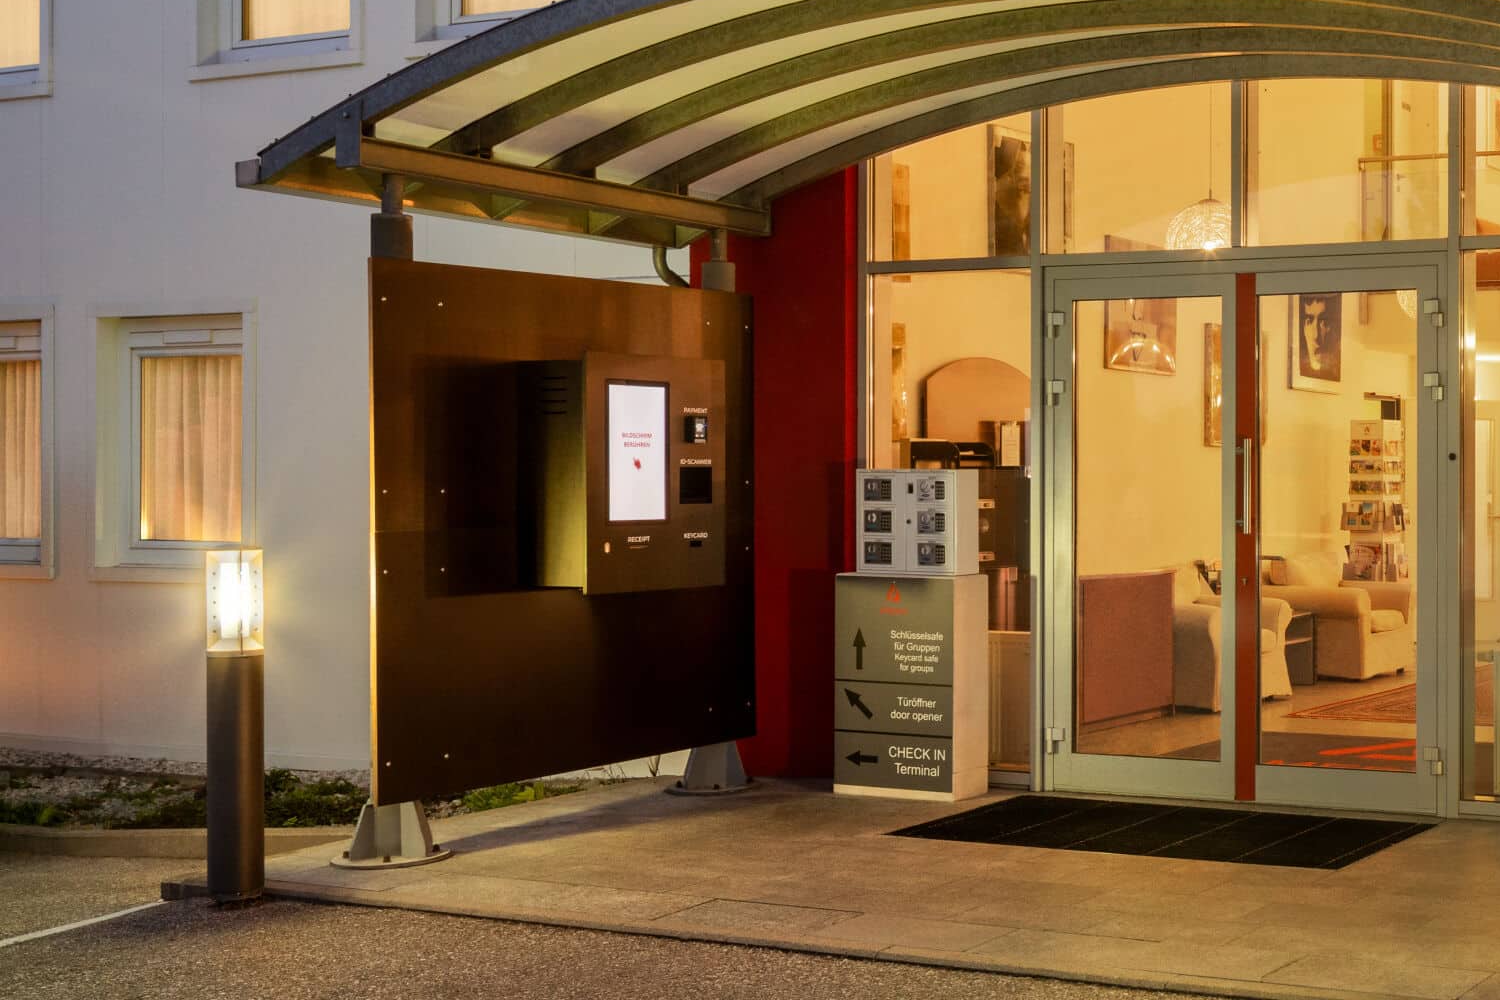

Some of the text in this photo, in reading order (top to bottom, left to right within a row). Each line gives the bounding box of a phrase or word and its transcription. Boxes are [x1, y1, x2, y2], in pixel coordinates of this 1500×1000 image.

[628, 535, 651, 543] RECEIPT
[890, 629, 944, 641] Schlüsselsafe
[894, 642, 940, 653] für Gruppen
[894, 653, 939, 663] Keycard safe
[900, 663, 934, 674] for groups
[896, 696, 936, 708] Türöffner
[890, 709, 943, 723] door opener
[888, 745, 946, 761] CHECK IN
[894, 762, 940, 777] Terminal
